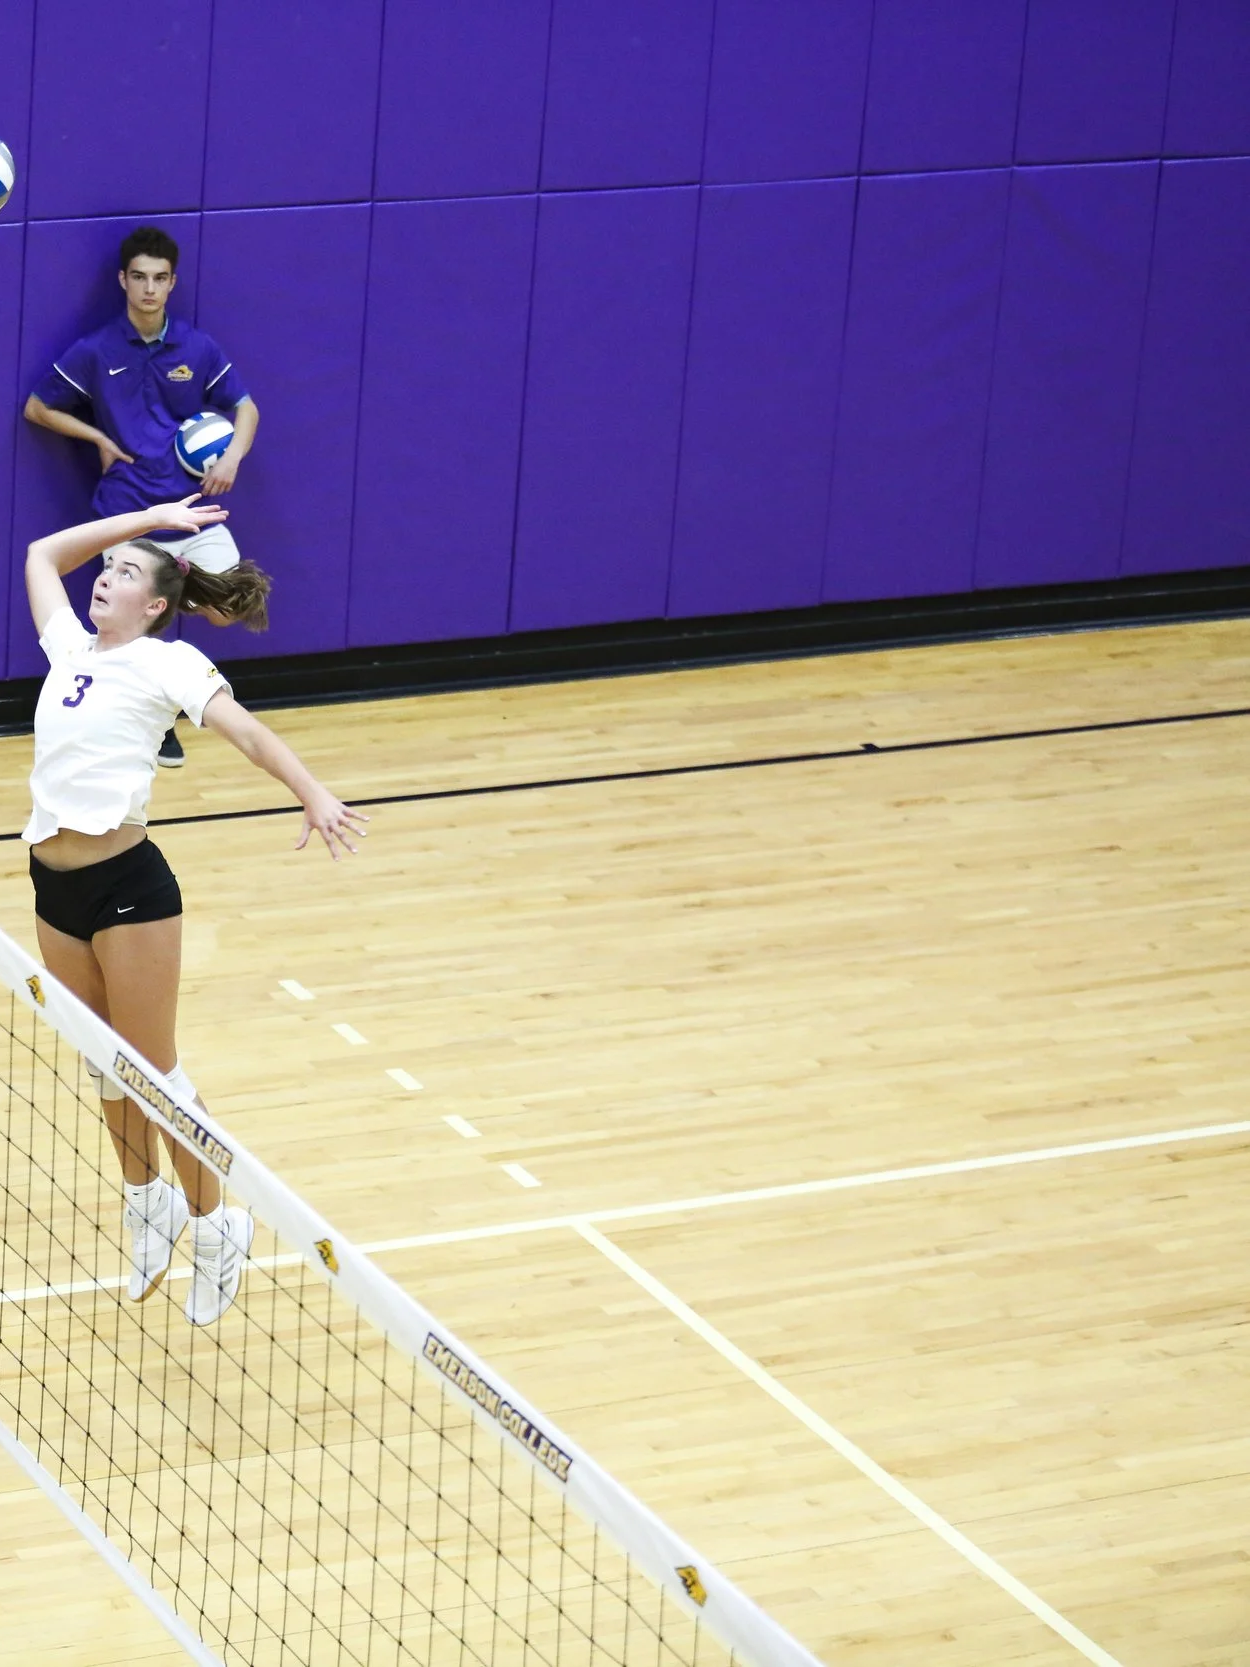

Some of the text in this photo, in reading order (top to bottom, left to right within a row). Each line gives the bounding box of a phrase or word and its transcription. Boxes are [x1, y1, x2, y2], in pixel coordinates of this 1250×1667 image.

[62, 674, 94, 708] 3
[113, 1050, 233, 1176] EMERSON COLLEGE
[422, 1331, 573, 1483] EMERSON COLLEGE
